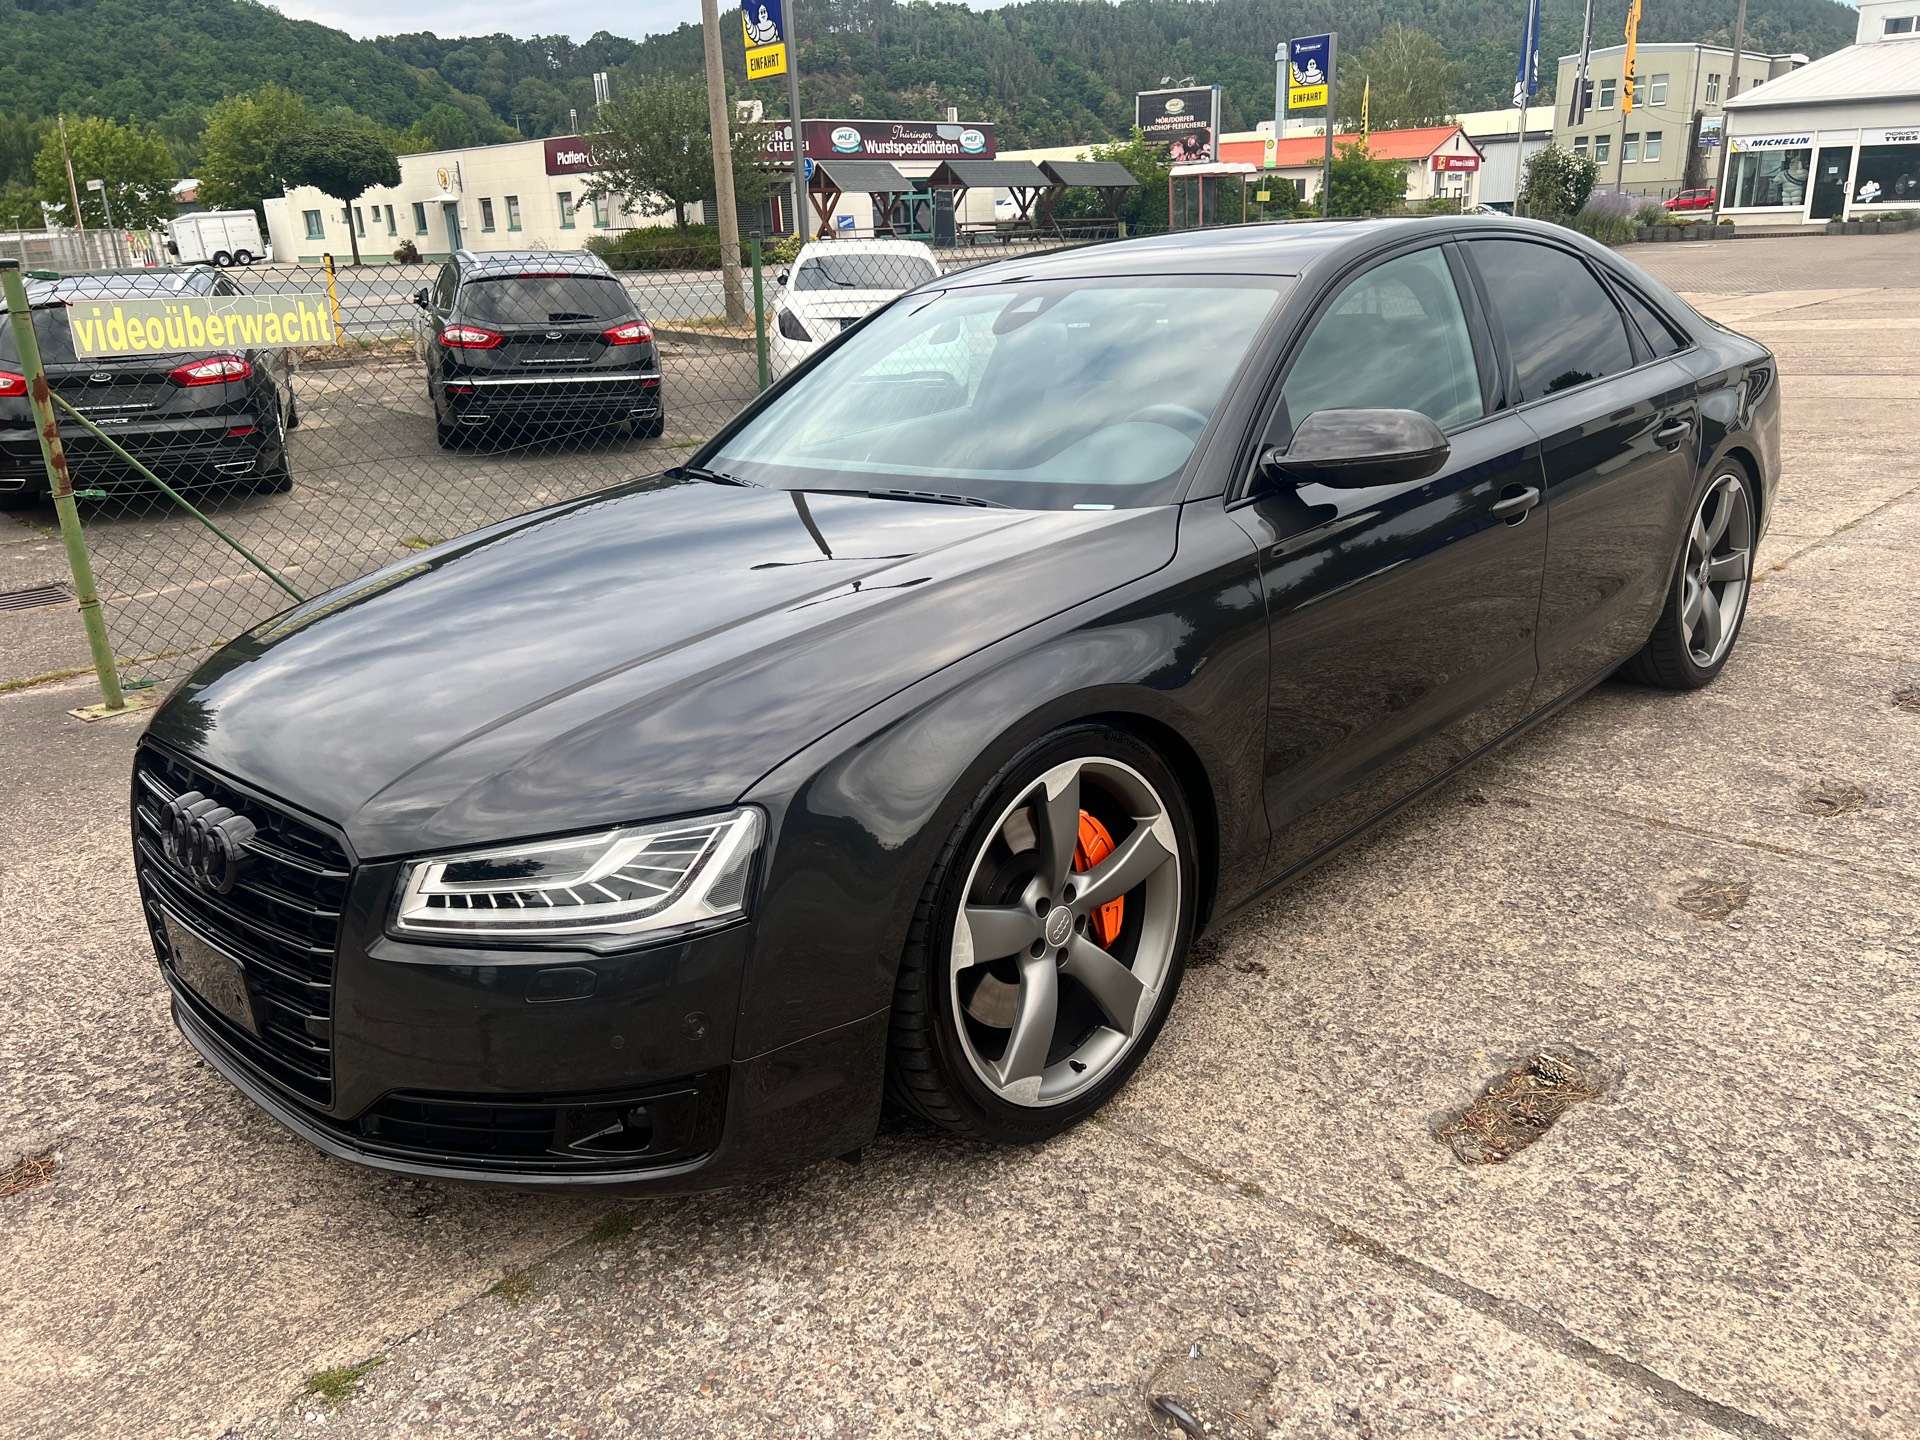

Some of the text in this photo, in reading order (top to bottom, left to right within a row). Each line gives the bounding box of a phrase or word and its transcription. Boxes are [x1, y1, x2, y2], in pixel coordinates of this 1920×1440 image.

[750, 53, 779, 72] EINFAHRT
[1293, 91, 1322, 104] EINFAHRT
[892, 125, 933, 143] Thüringer
[1751, 137, 1811, 147] MICHELIN
[864, 138, 959, 157] Wurstspezialitäten
[73, 301, 332, 352] videoüberwacht
